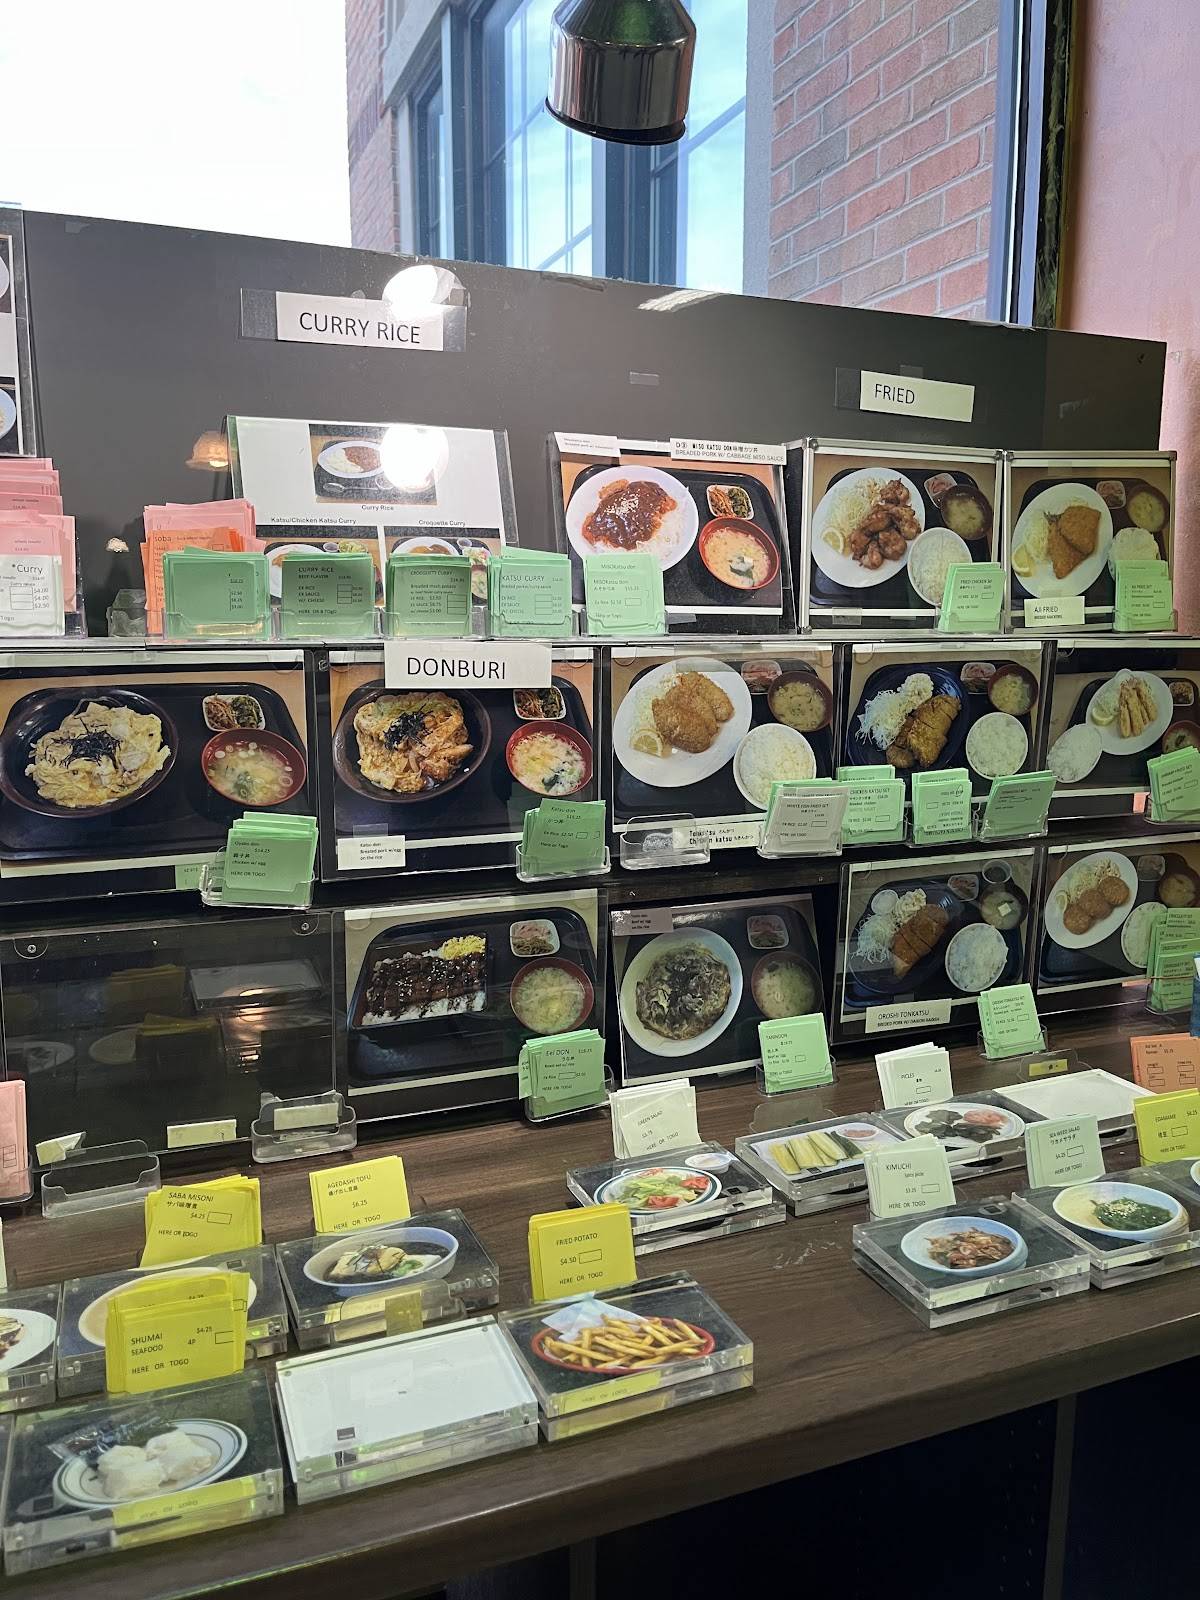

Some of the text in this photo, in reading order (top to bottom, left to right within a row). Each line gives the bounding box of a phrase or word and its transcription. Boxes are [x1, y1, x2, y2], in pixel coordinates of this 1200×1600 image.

[299, 312, 421, 344] CURRY RICE
[874, 384, 915, 404] FRIED
[407, 657, 505, 680] DONBURI
[900, 1009, 929, 1018] TONKATSU
[328, 1180, 356, 1189] AGEDASHI
[352, 1199, 368, 1208] $6.25
[364, 1214, 381, 1223] TOGO
[556, 1232, 598, 1247] FRIED POTATO
[560, 1256, 577, 1266] $4.50
[131, 1333, 163, 1345] SHUMAI
[131, 1344, 163, 1357] SEAFOOD
[132, 1365, 149, 1375] HERE
[170, 1358, 189, 1367] TOGO
